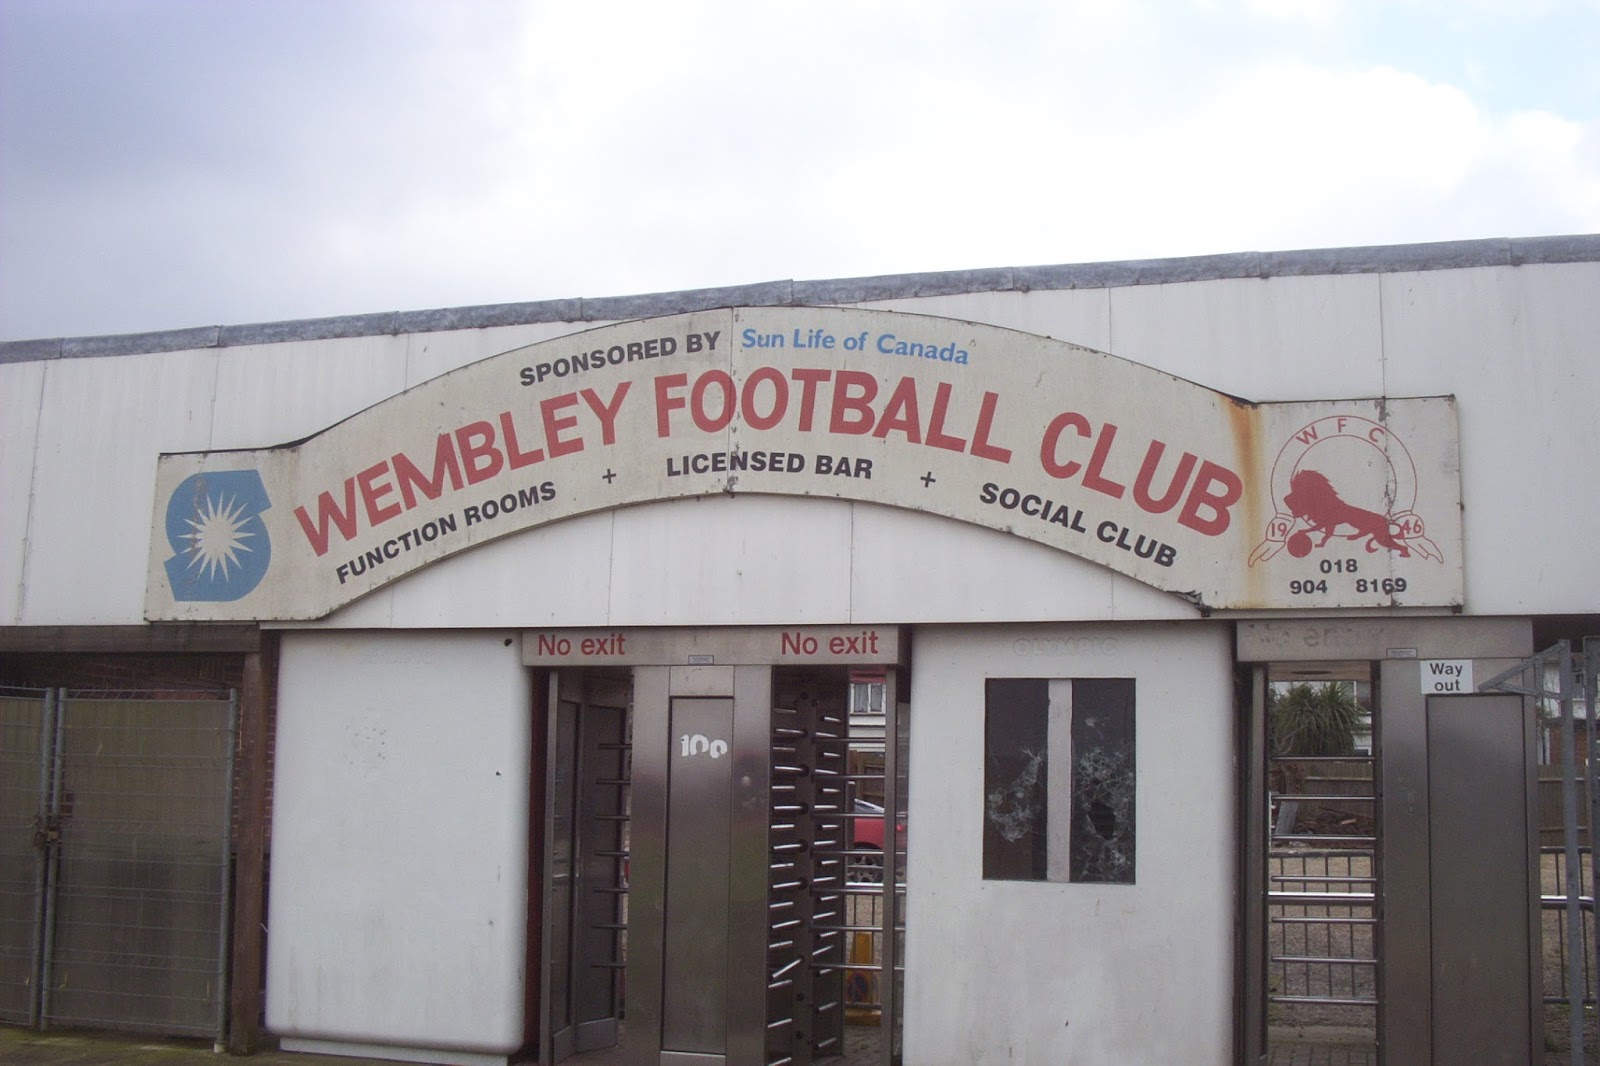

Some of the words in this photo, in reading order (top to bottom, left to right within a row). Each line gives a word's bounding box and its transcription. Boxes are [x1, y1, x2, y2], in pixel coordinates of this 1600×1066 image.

[742, 328, 785, 349] Sun
[793, 328, 836, 349] Life
[844, 331, 868, 351] of
[877, 334, 969, 365] Canada
[519, 336, 677, 387] SPONSORED
[686, 330, 721, 354] BY
[293, 381, 632, 557] WEMBLEY
[654, 366, 1012, 464] FOOTBALL
[1039, 411, 1245, 537] CLUB
[335, 513, 458, 584] FUNCTION
[463, 481, 556, 527] ROOMS
[666, 450, 806, 477] LICENSED
[814, 454, 873, 480] BAR
[979, 482, 1087, 534] SOCIAL
[1096, 520, 1177, 568] CLUB
[1270, 522, 1288, 538] 19
[1319, 558, 1359, 575] 018
[1289, 579, 1328, 595] 904
[1355, 577, 1408, 595] 8169
[537, 634, 572, 656] No
[580, 633, 626, 656] exit
[781, 631, 819, 655] No
[828, 630, 879, 655] exit
[1429, 662, 1463, 677] Way
[1434, 679, 1461, 692] out
